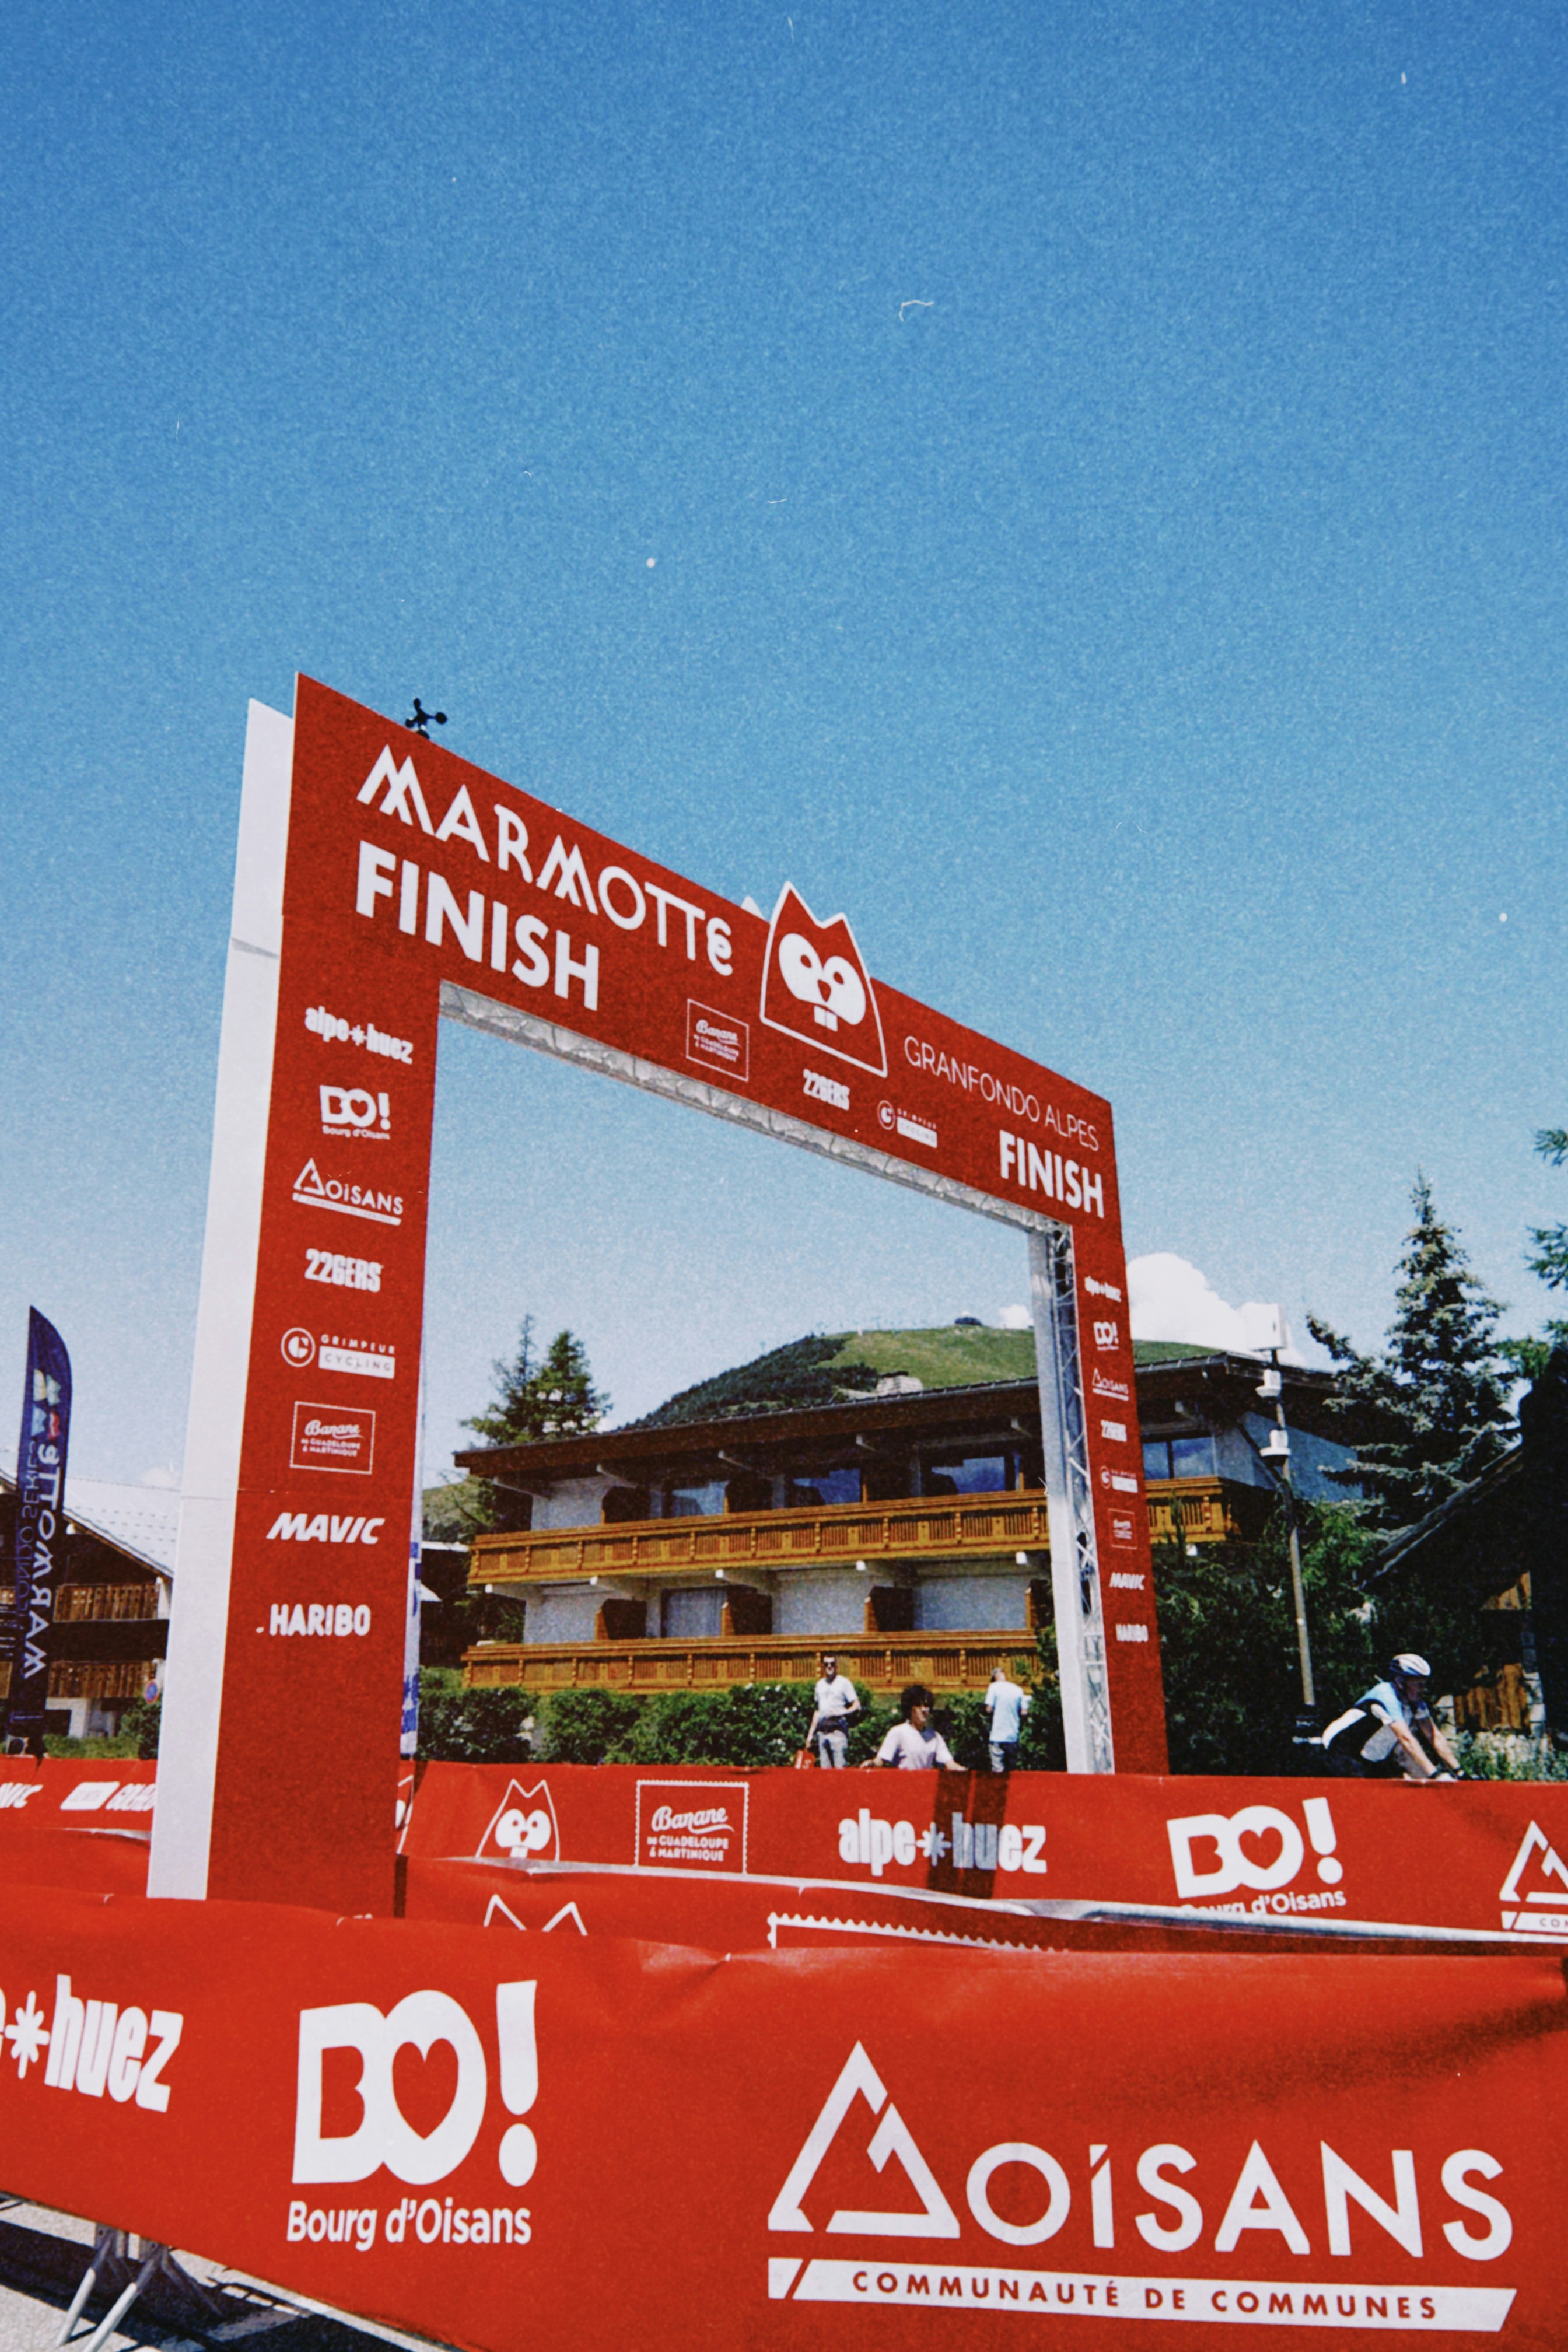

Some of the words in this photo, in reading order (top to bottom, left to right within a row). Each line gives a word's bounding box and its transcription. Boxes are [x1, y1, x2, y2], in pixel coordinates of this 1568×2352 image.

[356, 841, 599, 1012] FINISH
[905, 1036, 1040, 1122] GRANFONDO
[1045, 1104, 1099, 1152] ALPES
[1000, 1130, 1104, 1219] FINISH
[304, 1248, 382, 1293] 226ERS
[321, 1334, 395, 1355] GRIMPEUR
[325, 1353, 391, 1372] CYCLING
[304, 1419, 365, 1440] Banane
[266, 1512, 386, 1545] MAVIC
[1110, 1572, 1145, 1591] MAVIC
[270, 1604, 371, 1637] HARIBO
[651, 1805, 734, 1835] Banane
[657, 1847, 724, 1862] MARTINIQUE
[659, 1835, 729, 1850] GUADELOUPE
[286, 2200, 377, 2252] Bourg
[385, 2197, 532, 2245] d'Oisans
[852, 2270, 1120, 2307] COMMUNAUTÉ
[1145, 2288, 1186, 2311] DE
[1211, 2290, 1436, 2319] COMMUNES
